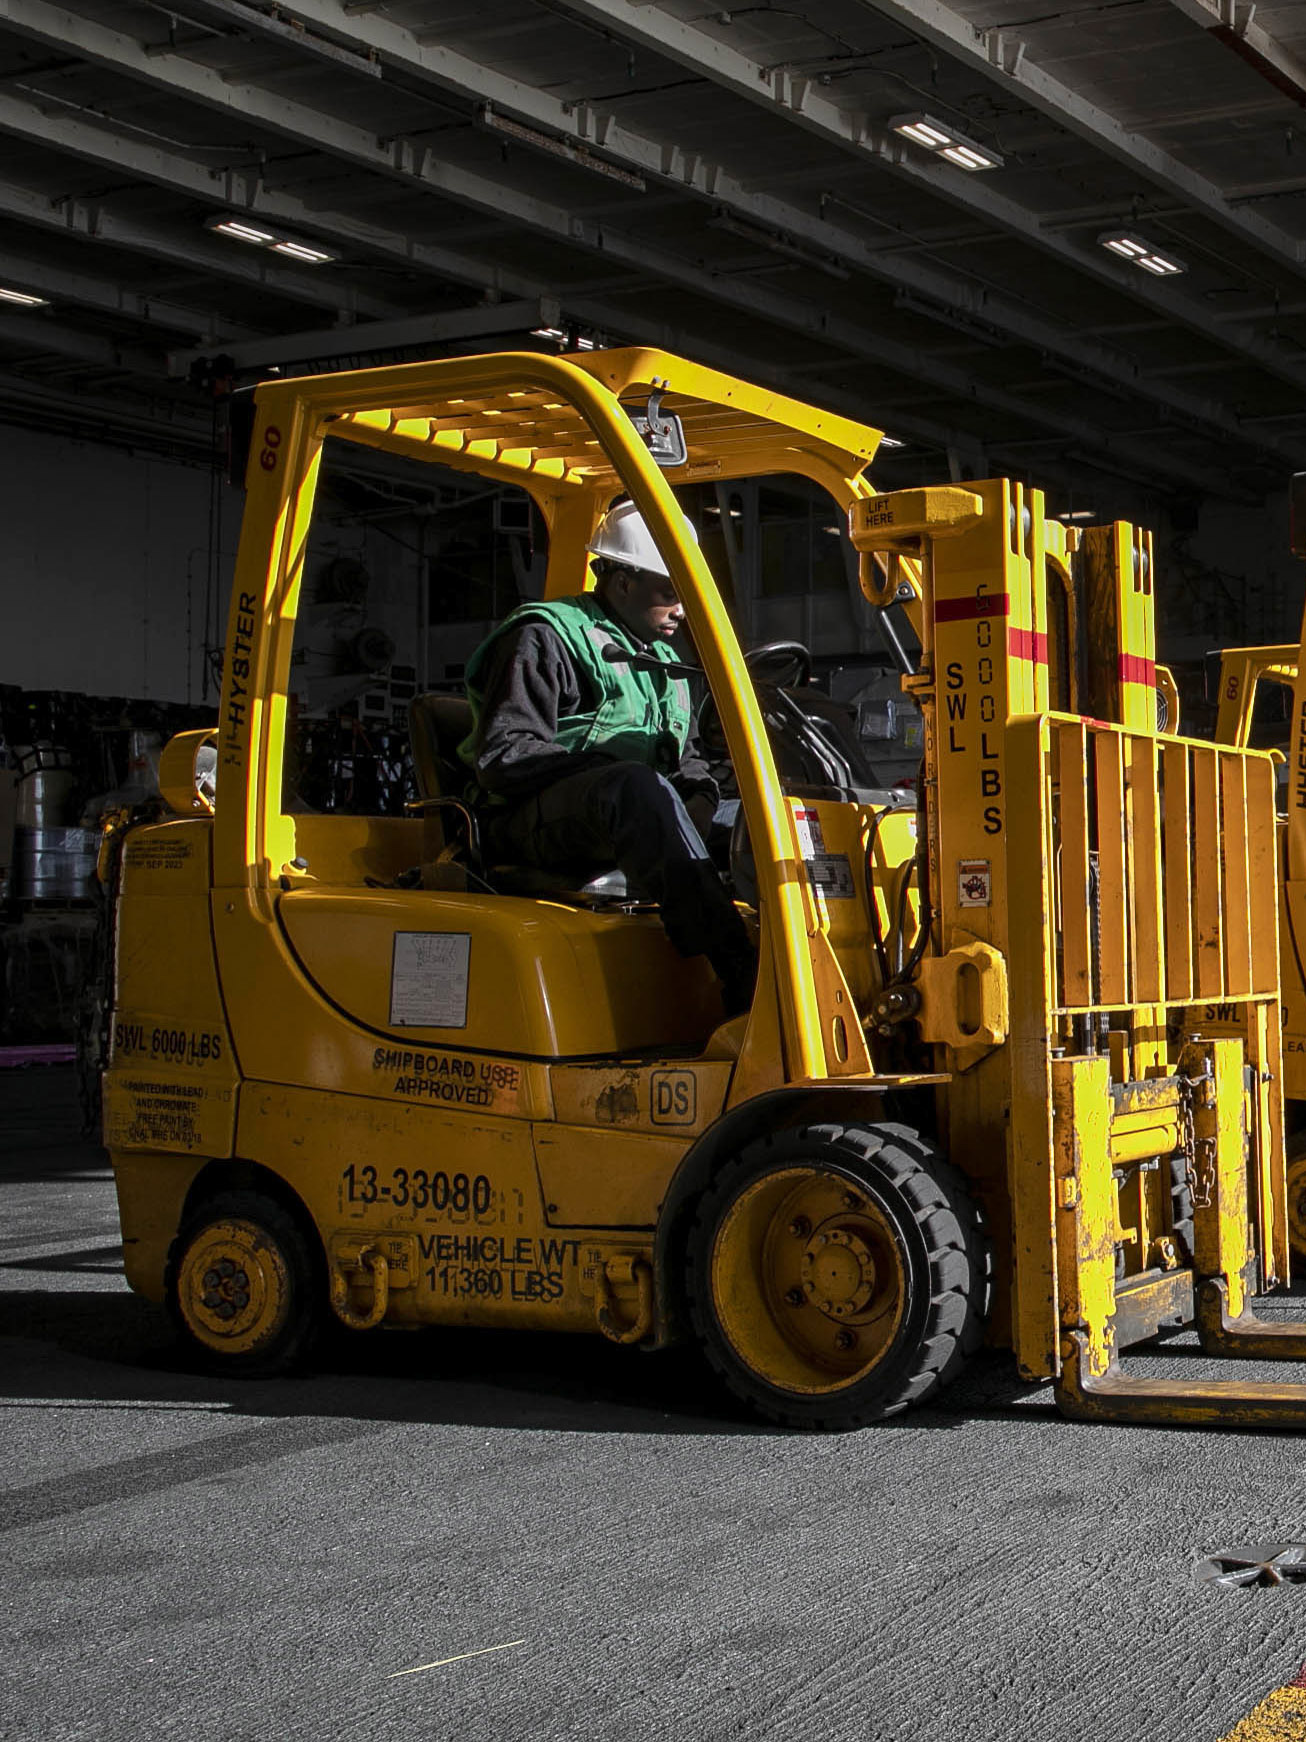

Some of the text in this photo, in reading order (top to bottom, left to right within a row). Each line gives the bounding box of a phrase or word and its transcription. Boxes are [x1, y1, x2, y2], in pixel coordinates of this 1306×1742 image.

[260, 425, 281, 472] 60
[865, 512, 894, 527] HERE
[868, 500, 888, 513] LIFT
[229, 592, 256, 726] HYSTER
[1226, 676, 1239, 701] 60
[946, 663, 967, 753] SWL
[1205, 1003, 1241, 1022] SWL
[115, 1024, 221, 1059] SWL 6000 LBS
[373, 1047, 476, 1078] SHIPBOARD
[393, 1077, 493, 1107] APPROVED
[657, 1080, 689, 1114] DS
[342, 1164, 492, 1214] 13-33080
[416, 1234, 582, 1266] VEHICLE WT
[425, 1266, 565, 1299] 11,360 LBS
